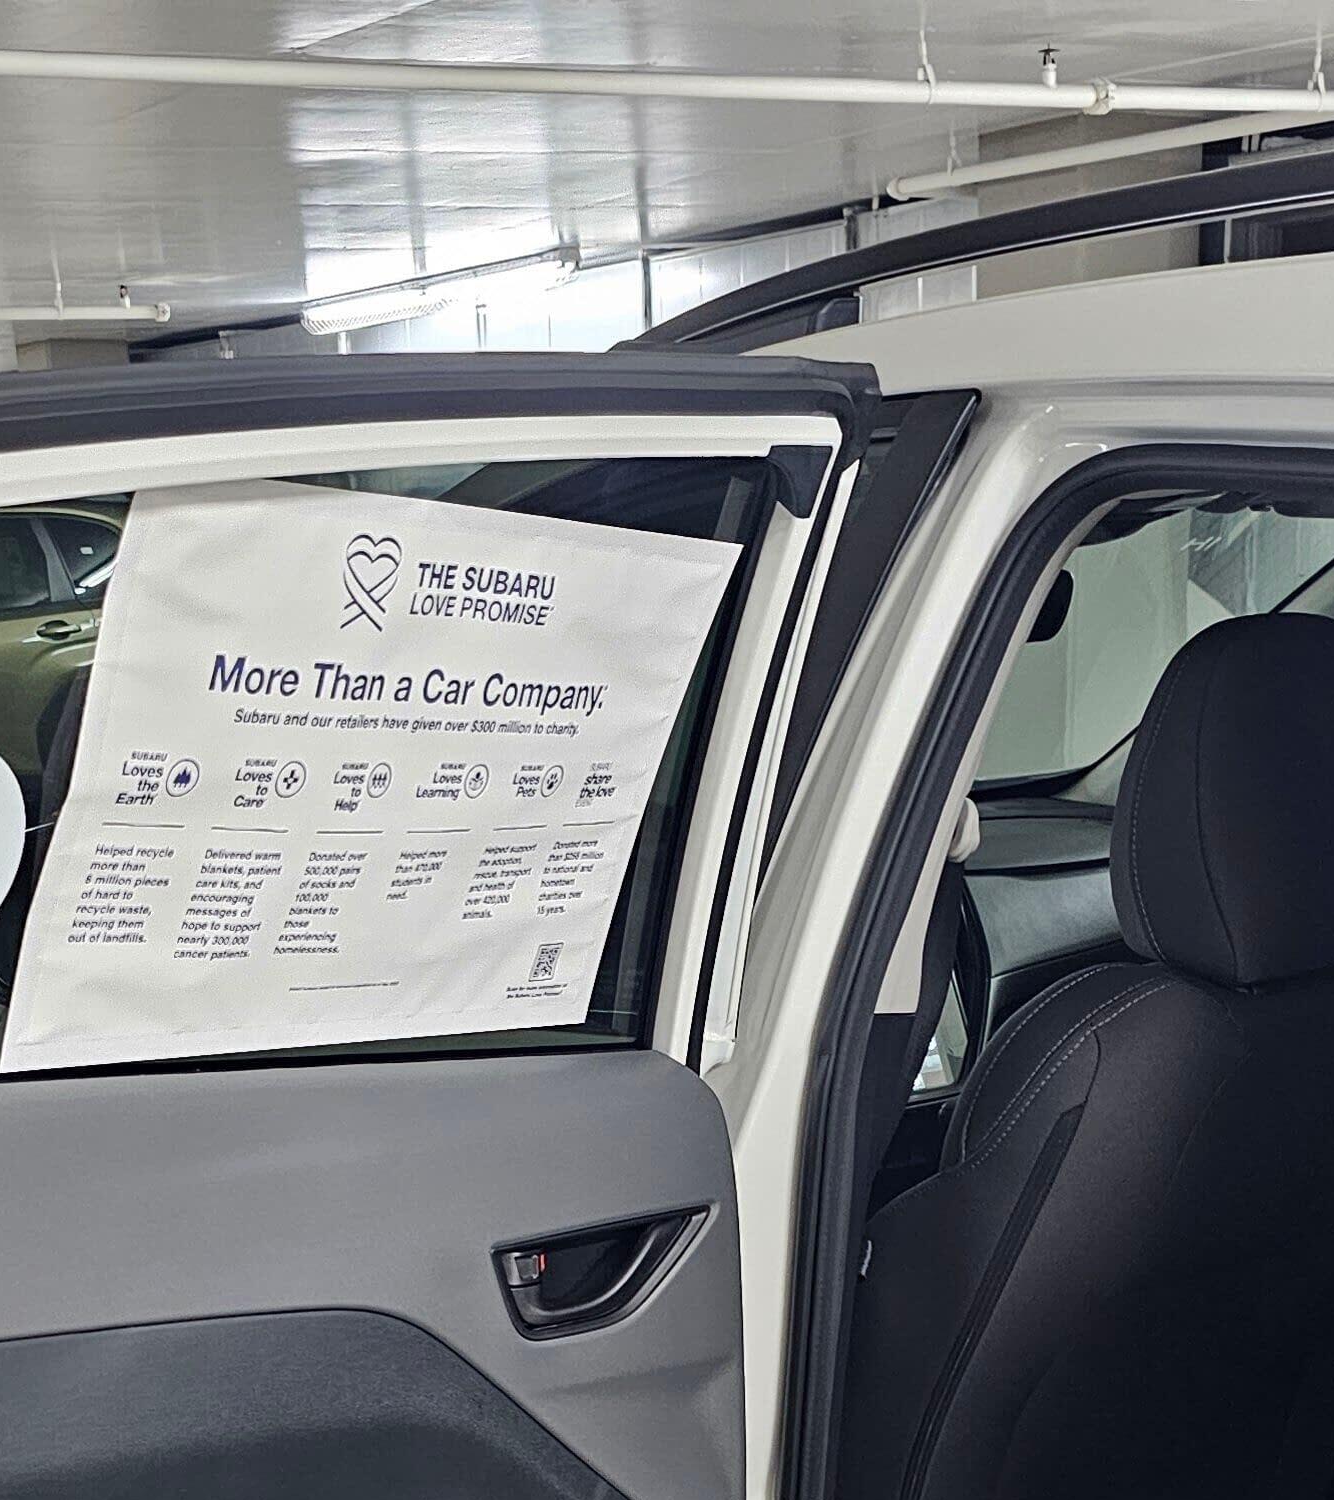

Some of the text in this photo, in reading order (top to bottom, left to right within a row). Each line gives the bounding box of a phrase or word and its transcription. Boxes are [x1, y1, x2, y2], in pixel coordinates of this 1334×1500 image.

[417, 562, 555, 600] THE SUBARU
[410, 592, 550, 626] LOVE PROMISE
[208, 654, 604, 717] More Than a Car Company.
[233, 708, 579, 738] Subaru and our retailers have given over $300 million to charity.
[131, 750, 168, 762] SUBARU
[245, 759, 278, 767] SUBARU
[122, 761, 164, 778] Loves
[235, 768, 273, 783] Loves
[333, 771, 365, 785] Loves
[433, 771, 463, 784] Loves
[512, 773, 540, 785] Loves
[584, 772, 613, 785] share
[137, 779, 160, 792] the
[255, 784, 268, 796] to
[516, 786, 537, 797] Pets
[350, 787, 362, 798] to
[416, 785, 461, 801] Learning
[579, 785, 616, 799] the love
[115, 793, 154, 806] Earth
[233, 795, 266, 808] Care
[334, 799, 358, 813] Help
[94, 843, 174, 860] Helped recycle
[204, 848, 282, 860] Delivered warm
[398, 849, 448, 861] Helped more
[482, 843, 538, 855] Helped support
[308, 850, 368, 862] Donated over
[90, 860, 146, 871] more than
[394, 864, 413, 873] than
[478, 859, 491, 867] the
[200, 864, 282, 876] blankets, patient
[338, 866, 362, 877] pairs
[94, 874, 132, 886] million
[133, 876, 169, 888] pieces
[195, 879, 264, 890] care kits, and
[298, 878, 357, 889] of socks and
[390, 877, 423, 888] students
[80, 888, 133, 900] of hard to
[468, 883, 484, 893] and
[190, 893, 255, 906] encouraging
[464, 898, 482, 906] over
[75, 904, 152, 916] recycle waste,
[185, 907, 253, 919] messages of
[288, 906, 339, 916] blankets to
[72, 917, 144, 930] keeping them
[181, 920, 262, 933] hope to support
[283, 920, 310, 928] those
[67, 932, 147, 943] out of landfills.
[176, 934, 250, 947] nearly 300,000
[278, 931, 337, 943] experiencing
[173, 949, 250, 961] cancer patients.
[273, 945, 340, 955] homelessness.
